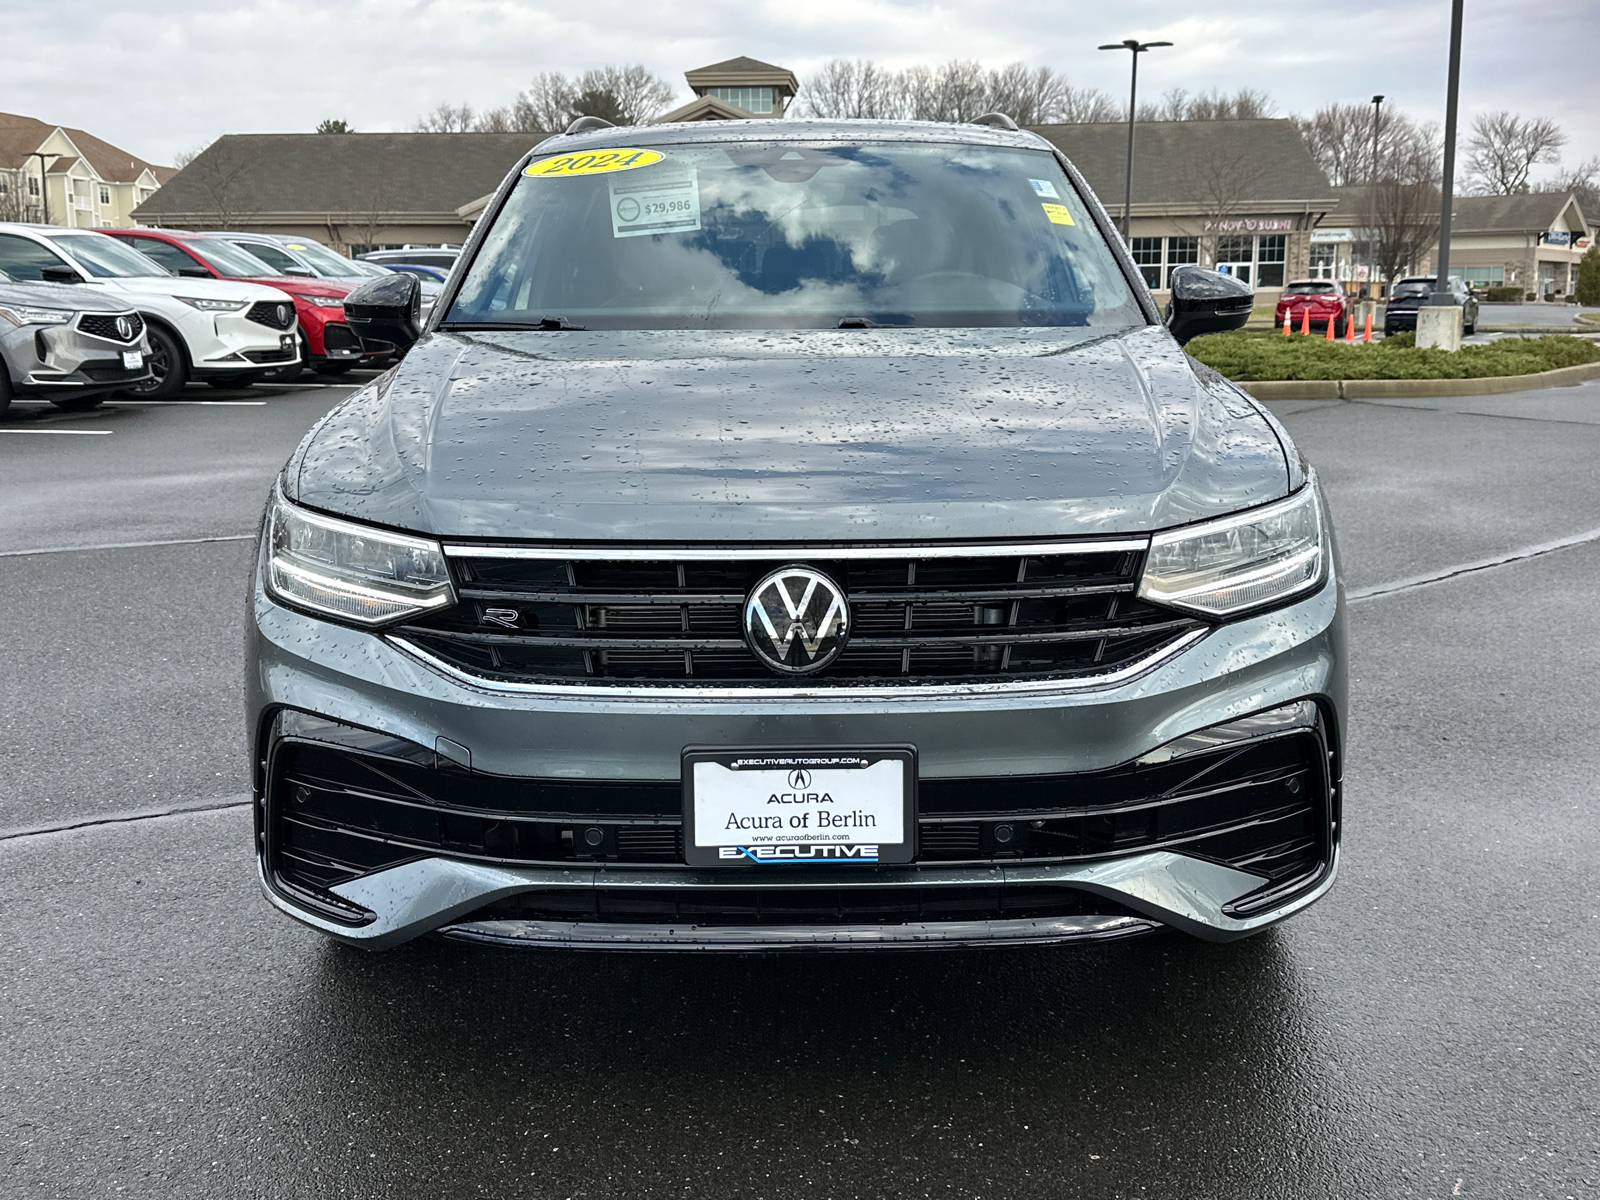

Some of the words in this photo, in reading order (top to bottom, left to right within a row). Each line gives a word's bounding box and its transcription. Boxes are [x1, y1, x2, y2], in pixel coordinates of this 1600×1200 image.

[542, 152, 644, 174] 2024
[644, 200, 691, 215] $29,986
[737, 757, 860, 766] EXECUTIVEAUTOGROUP.COM
[767, 792, 834, 804] ACURA
[724, 812, 783, 830] Acura
[789, 812, 810, 828] of
[817, 810, 877, 828] Berlin
[752, 833, 850, 842] www.acuraofberlin.com
[719, 844, 879, 861] EXECUTIVE
